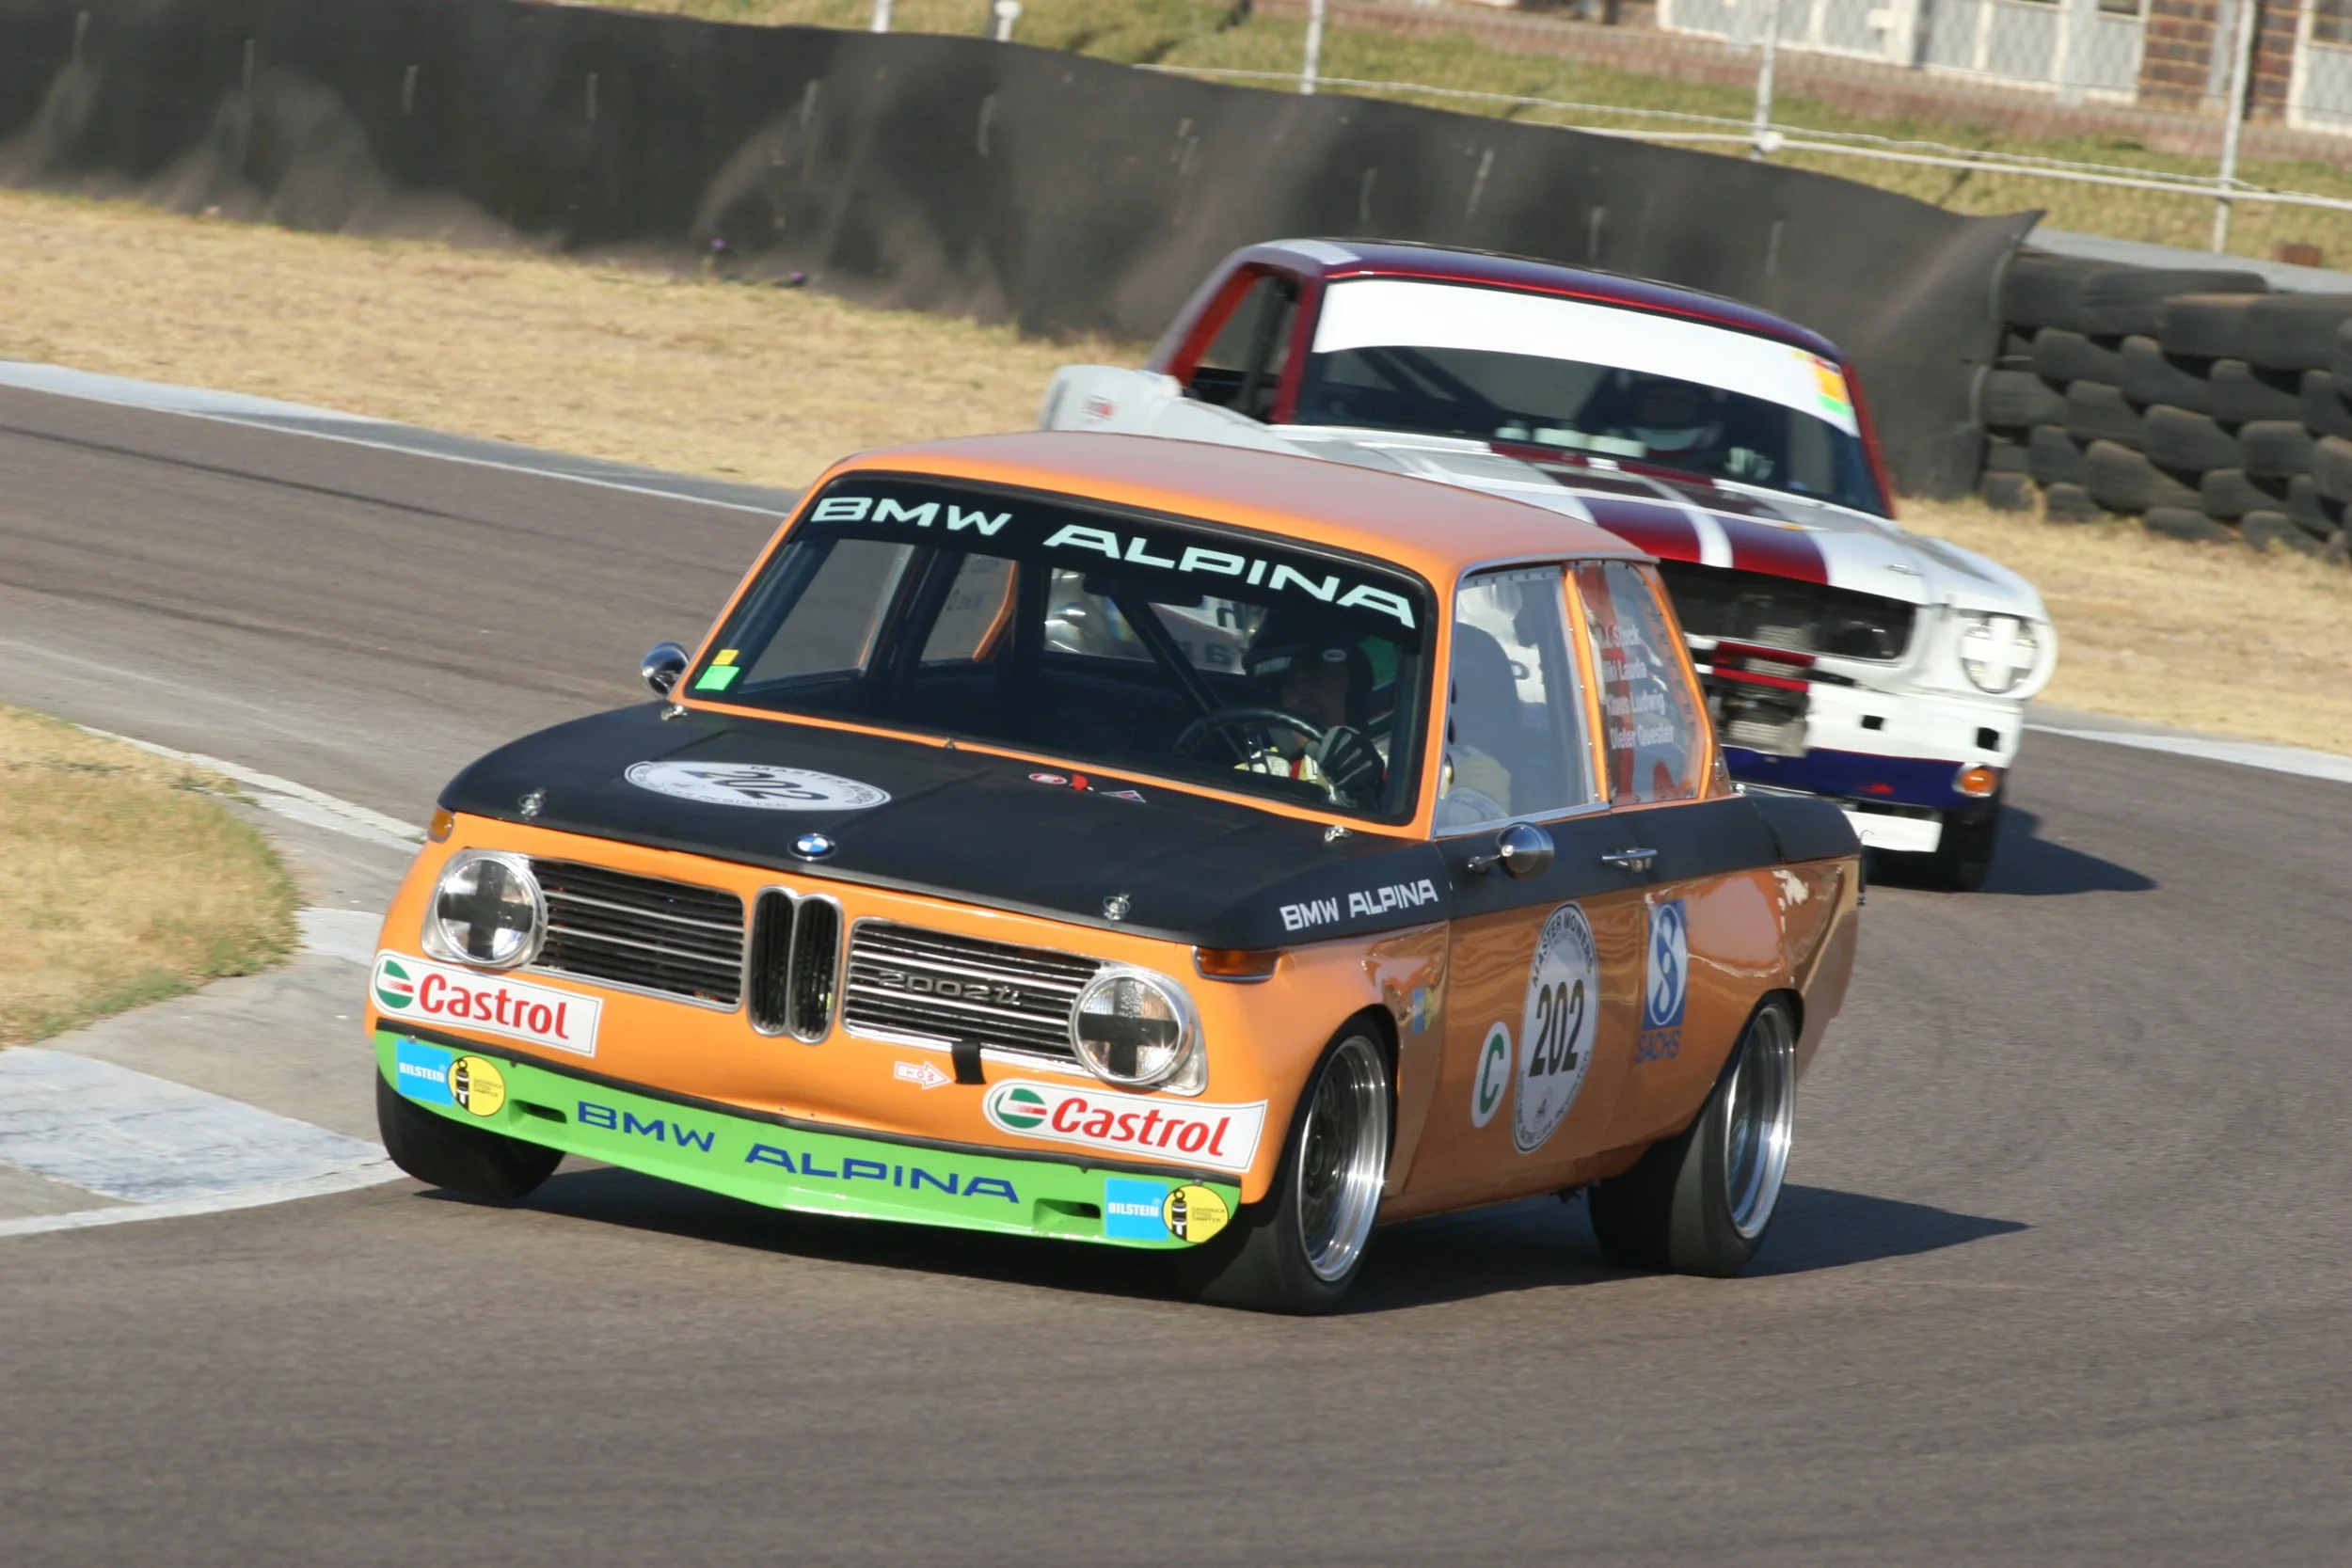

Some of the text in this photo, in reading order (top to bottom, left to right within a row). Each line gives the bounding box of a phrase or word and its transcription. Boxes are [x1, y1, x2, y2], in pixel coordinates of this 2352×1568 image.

[810, 497, 1012, 536] BMW
[1042, 524, 1416, 629] ALPINA
[1618, 657, 1647, 680] Lauda
[1629, 688, 1665, 716] Ludwig
[679, 769, 830, 800] 202
[1279, 879, 1439, 931] BMW ALPINA
[1532, 913, 1563, 988] MASTER
[419, 973, 569, 1040] Castrol
[1529, 978, 1586, 1078] 202
[399, 1062, 446, 1084] BILSTEIN
[1479, 1033, 1504, 1115] C
[1634, 1028, 1682, 1064] SACHS
[578, 1101, 1020, 1204] BMW ALPINA
[1051, 1097, 1231, 1157] Castrol
[1107, 1201, 1160, 1217] BILSTEIN
